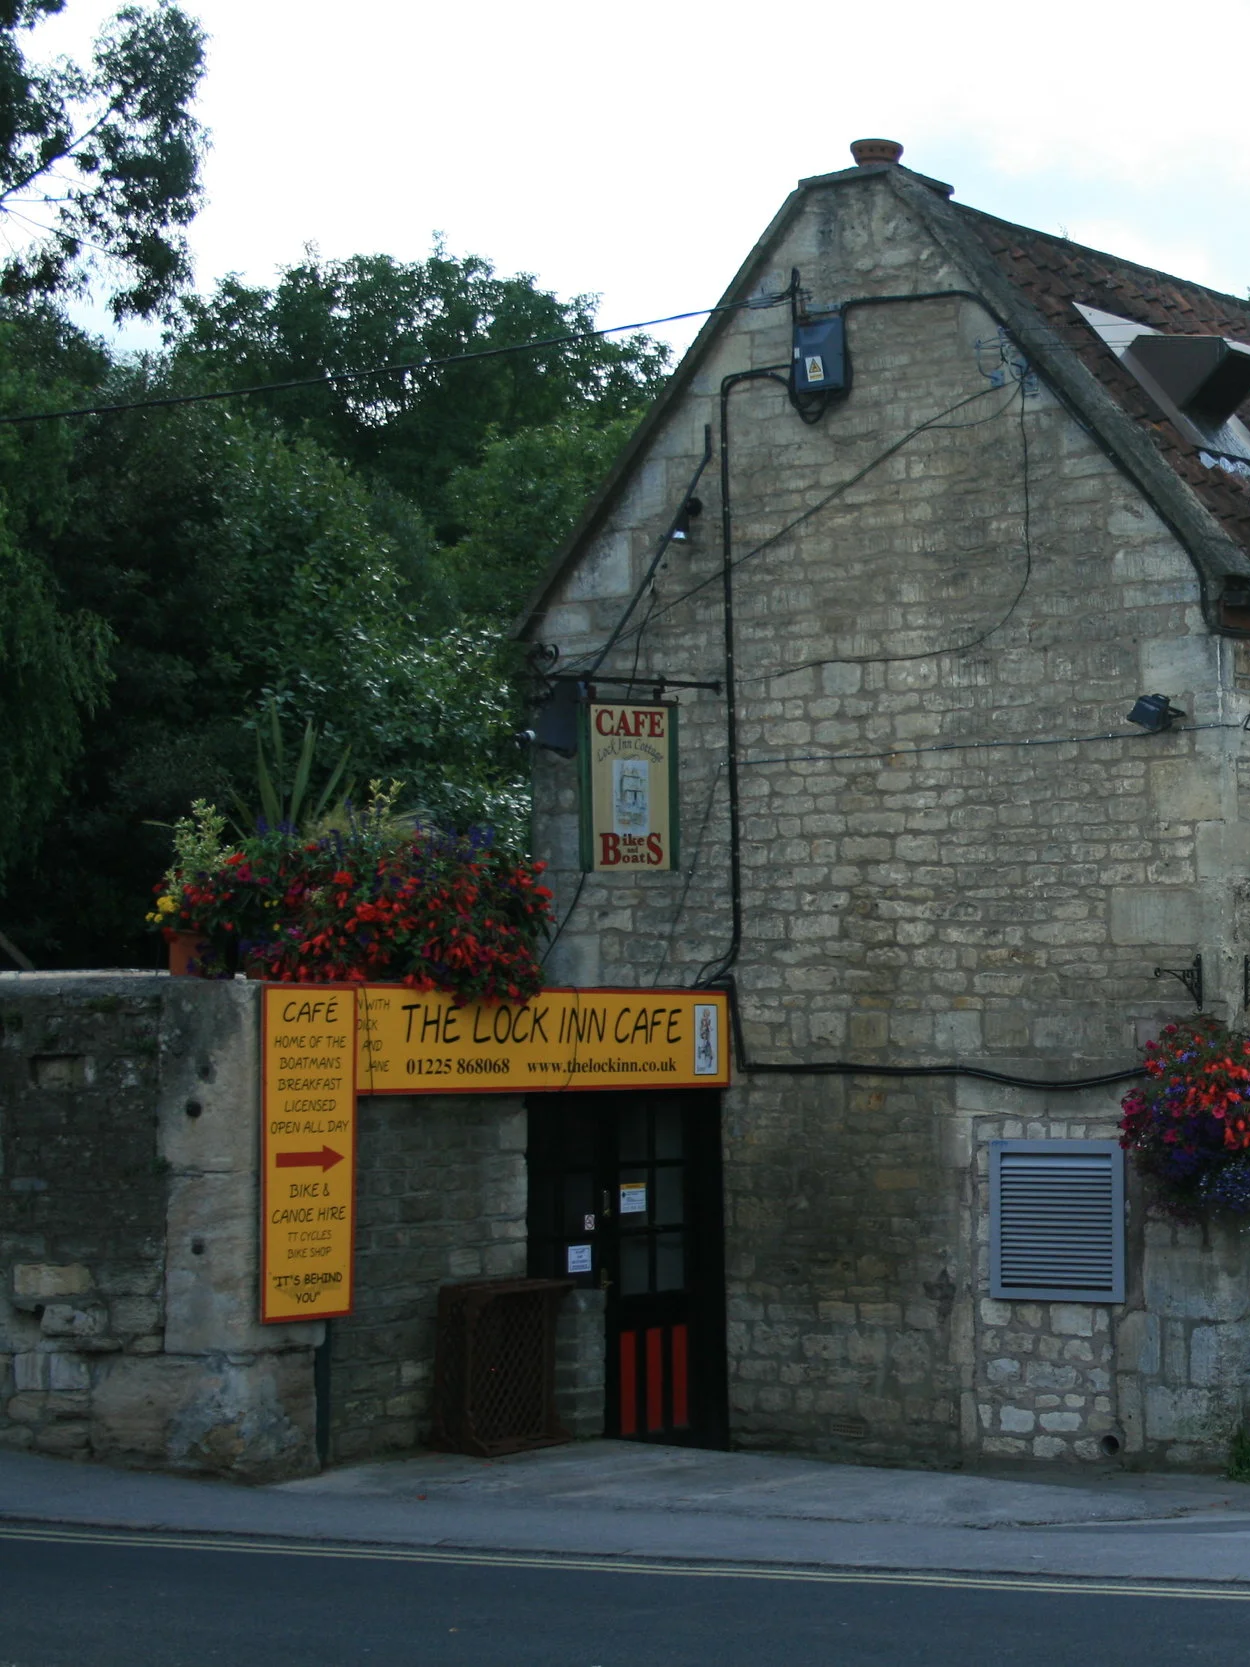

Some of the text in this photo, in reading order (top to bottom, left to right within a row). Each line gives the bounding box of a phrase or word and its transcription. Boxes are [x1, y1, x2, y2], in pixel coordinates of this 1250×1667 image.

[595, 708, 665, 738] CAFE
[283, 996, 338, 1023] CAFÉ
[366, 998, 390, 1011] WITH
[402, 1004, 682, 1044] THE LOCK INN CAFE
[274, 1035, 347, 1048] HOME OF THE
[361, 1039, 383, 1052] AND
[406, 1057, 677, 1075] 01225 868068 www.thelockinn.co.uk
[277, 1077, 342, 1091] BREAKFAST
[284, 1099, 337, 1113] LICENSED
[270, 1119, 350, 1135] OPEN ALL DAY
[289, 1182, 330, 1198] BIKE &
[271, 1205, 346, 1225] CANOE HIRE
[300, 1230, 332, 1242] CYCLES
[288, 1246, 332, 1259] BIKE SHOP
[304, 1271, 342, 1285] BEHIND
